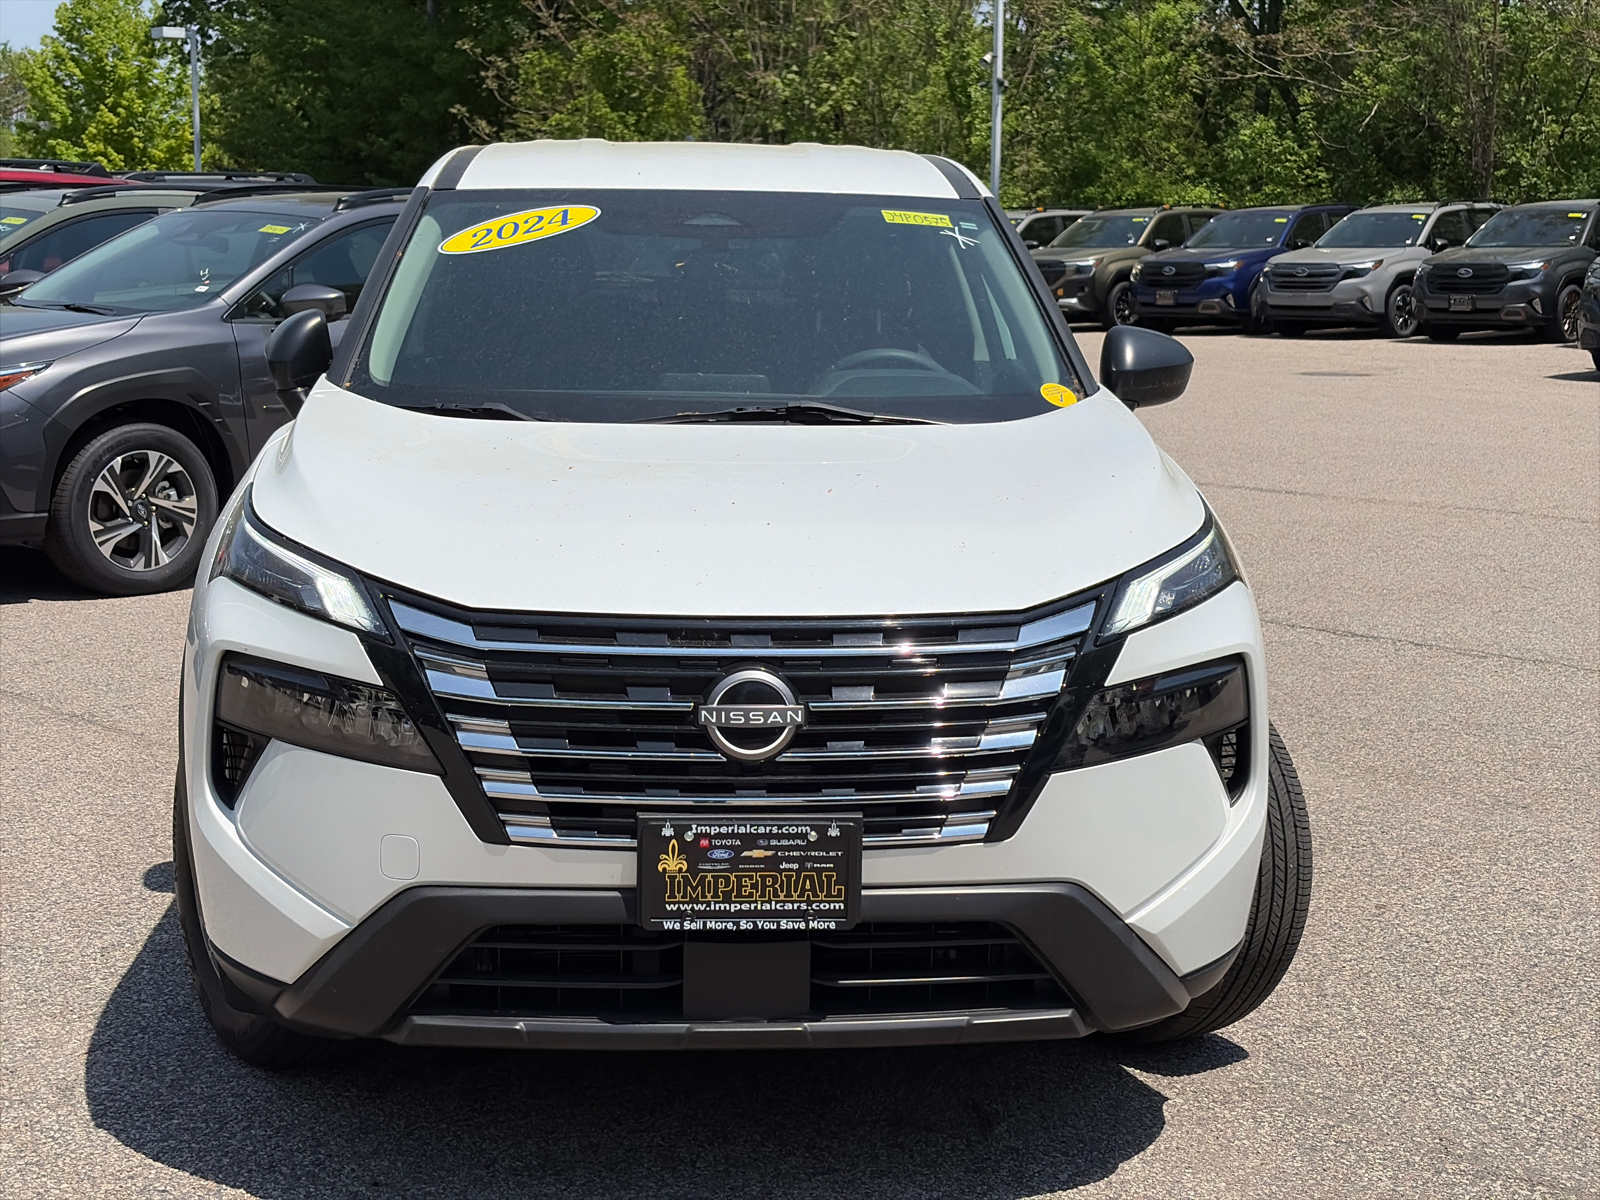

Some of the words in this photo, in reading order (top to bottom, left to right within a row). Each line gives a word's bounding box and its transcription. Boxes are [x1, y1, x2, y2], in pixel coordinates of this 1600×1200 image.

[470, 209, 574, 249] 2024
[701, 710, 802, 724] NISSAN
[691, 824, 811, 835] Imperialcars.com
[710, 850, 730, 859] Ford
[779, 861, 799, 870] Jeep
[665, 872, 845, 901] IMPERIAL
[665, 901, 844, 912] www.imperialcars.com
[663, 920, 681, 930] We
[683, 920, 703, 930] Sell
[706, 920, 737, 931] More,
[739, 920, 753, 930] So
[756, 920, 777, 930] You
[780, 920, 806, 930] Save
[809, 920, 836, 930] More
